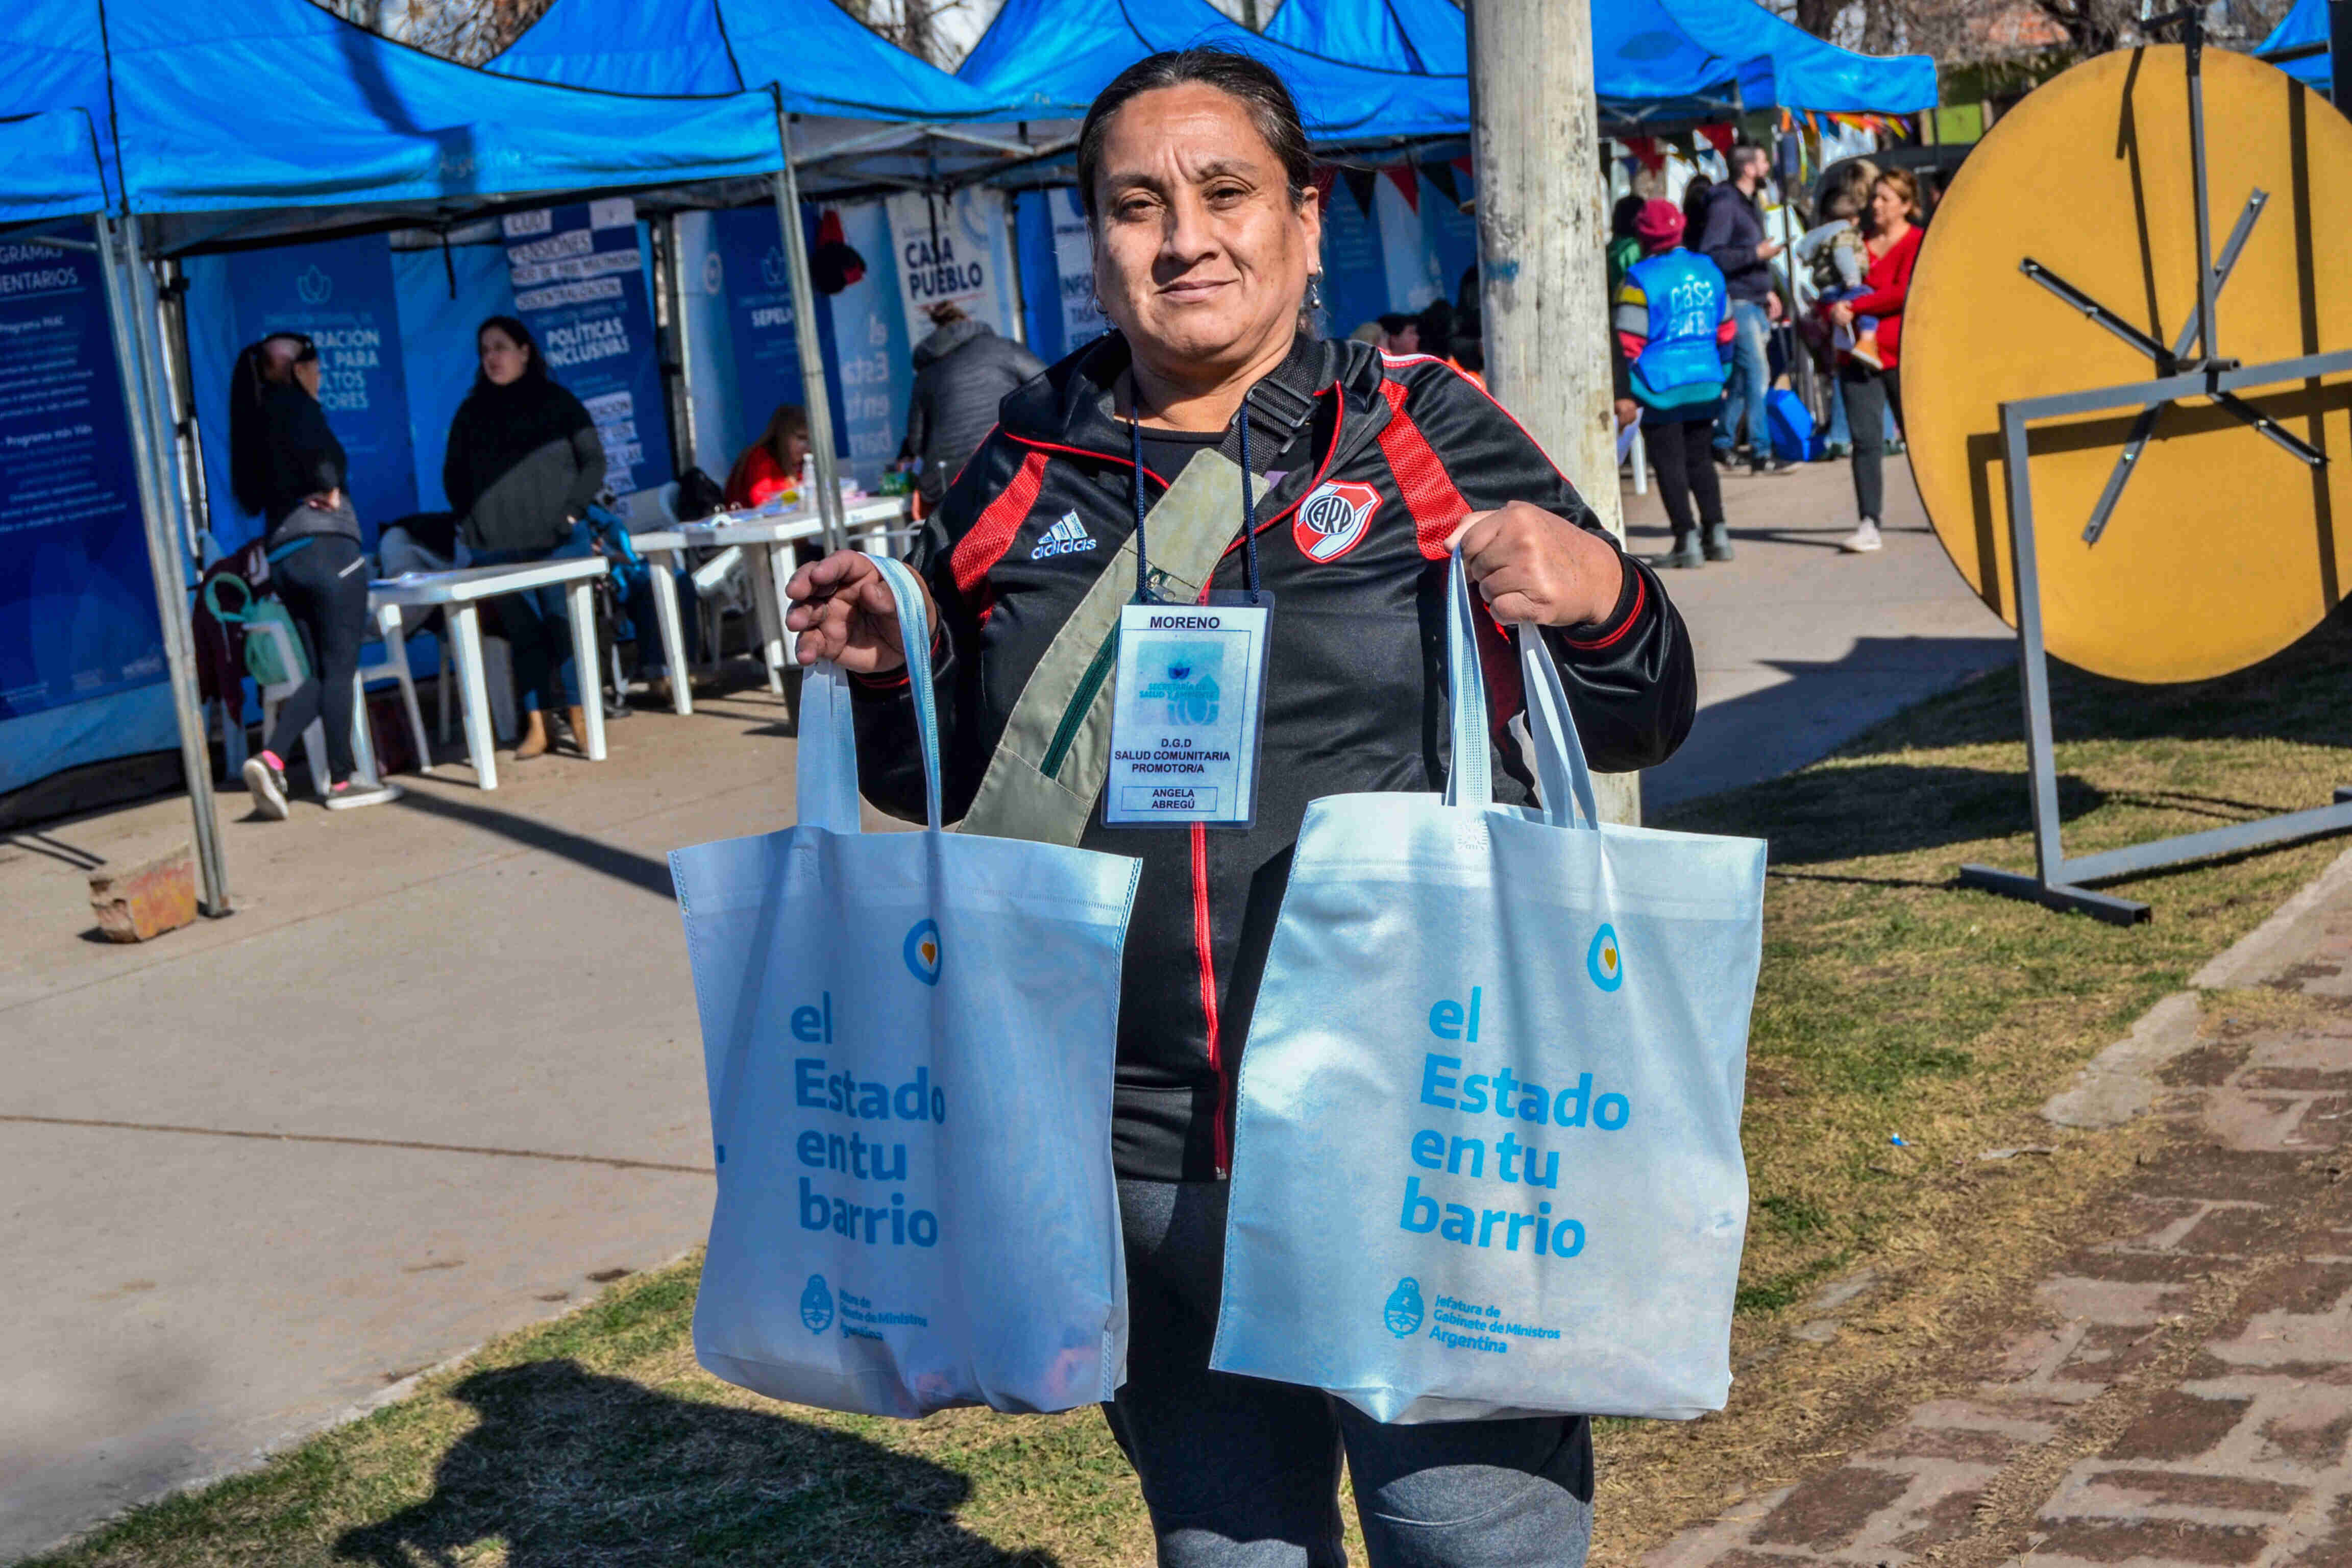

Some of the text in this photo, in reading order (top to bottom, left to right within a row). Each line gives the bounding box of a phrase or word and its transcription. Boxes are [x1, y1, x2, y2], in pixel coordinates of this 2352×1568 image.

[909, 261, 983, 301] PUEBLO
[547, 316, 624, 348] POLÍTICAS
[334, 350, 379, 366] PARA
[1030, 538, 1097, 560] adidas
[1149, 616, 1220, 629] MORENO
[1167, 691, 1173, 699] Y
[1161, 738, 1192, 748] D.G.D
[1114, 750, 1231, 761] SALUD COMUNITARIA
[1132, 764, 1205, 773] PROMOTOR/A
[1151, 798, 1195, 809] ABREGÚ
[1152, 789, 1195, 798] ANGELA
[790, 990, 833, 1045] el
[1429, 985, 1482, 1043] el
[794, 1058, 946, 1125] Estado
[1420, 1052, 1630, 1131] Estado
[798, 1175, 938, 1248] barrio
[1400, 1175, 1586, 1259] barrio
[1435, 1294, 1501, 1318] Jefatura de
[877, 1312, 928, 1328] Ministros
[1433, 1309, 1561, 1339] Gabinete de Ministros
[1429, 1325, 1508, 1354] Argentina
